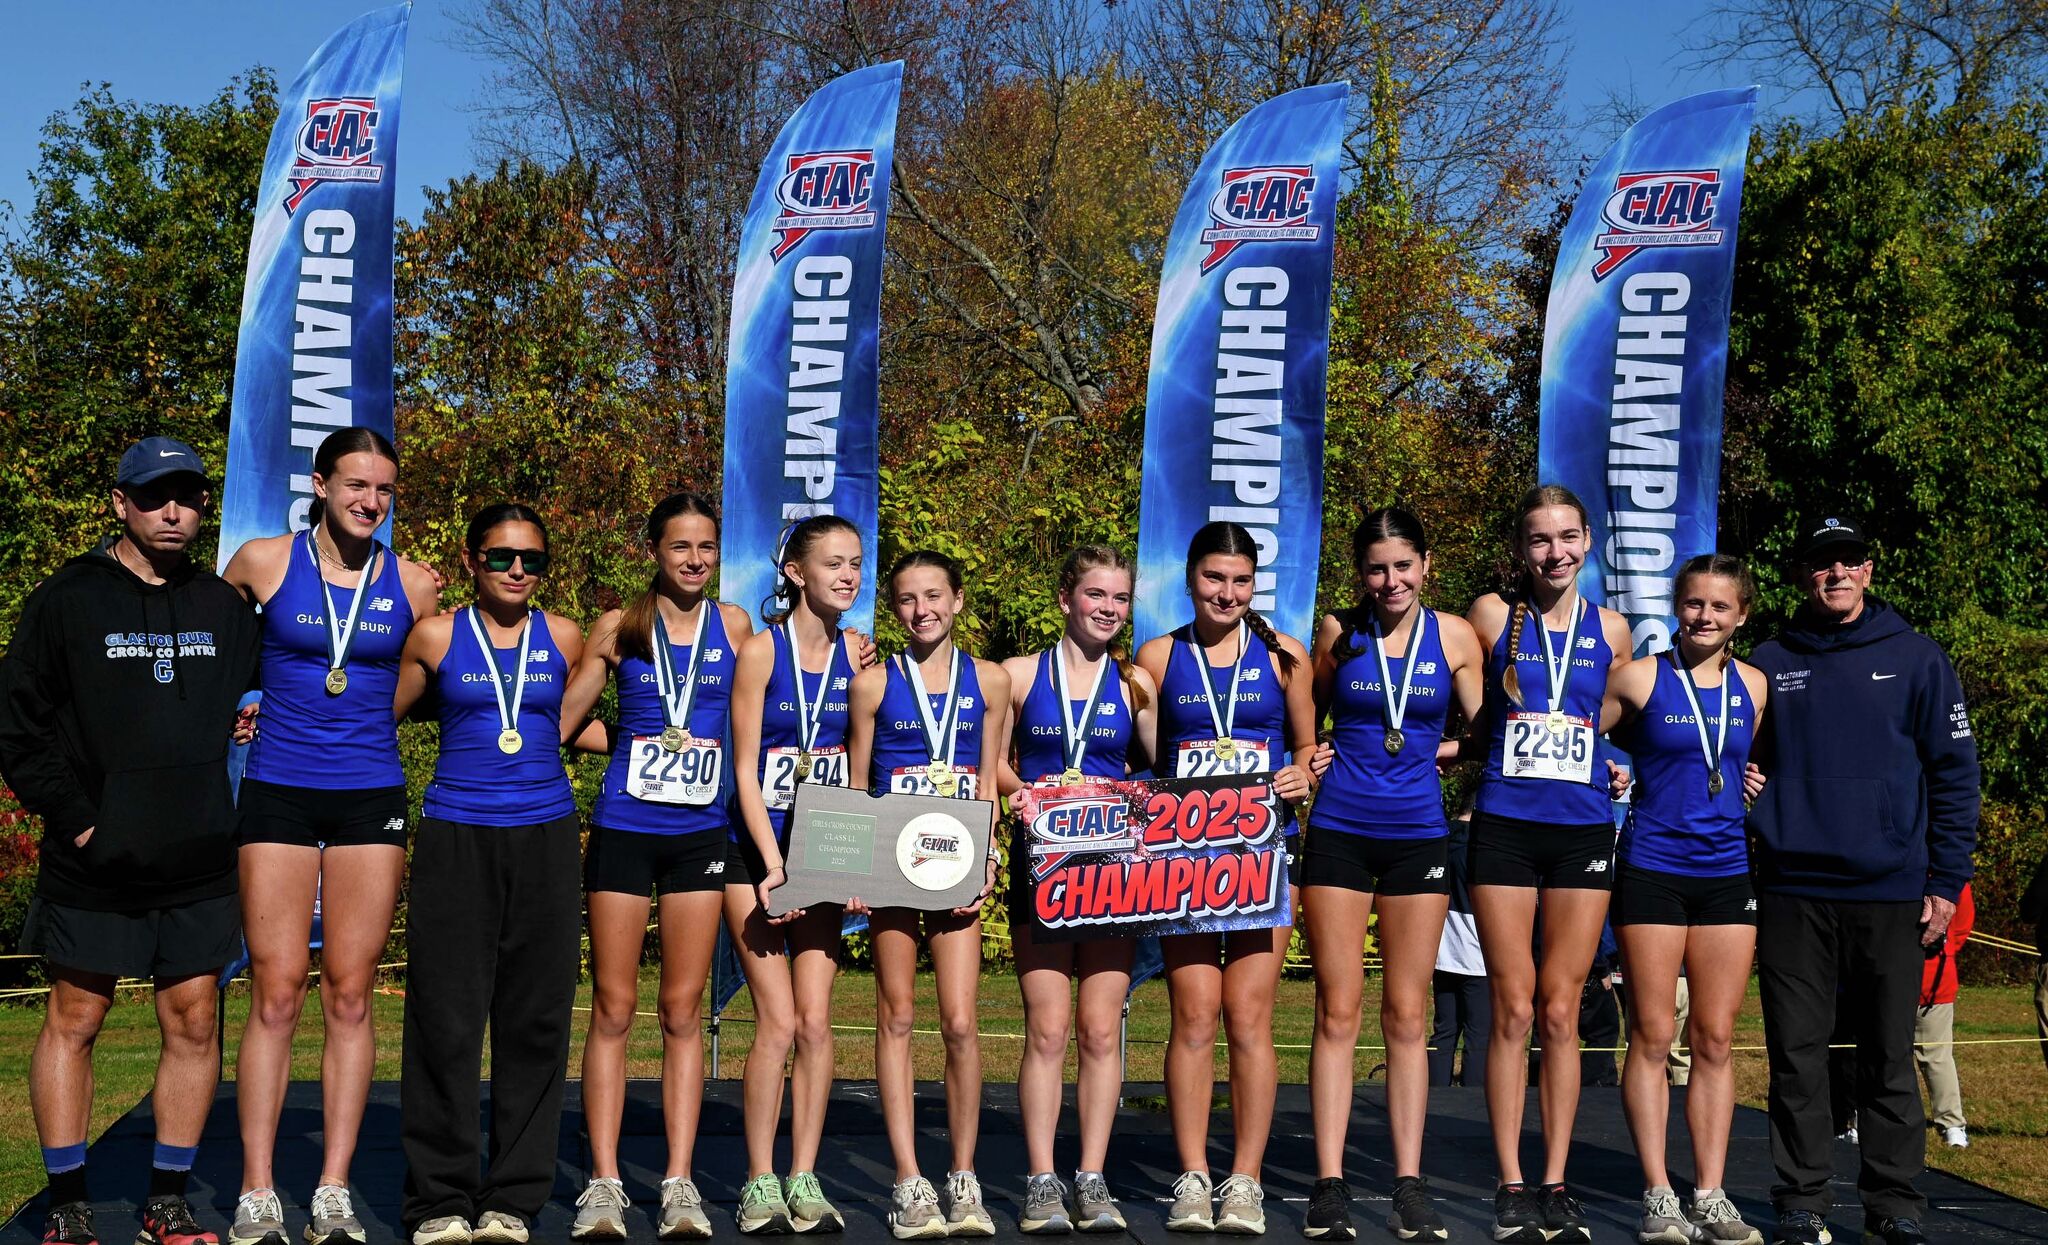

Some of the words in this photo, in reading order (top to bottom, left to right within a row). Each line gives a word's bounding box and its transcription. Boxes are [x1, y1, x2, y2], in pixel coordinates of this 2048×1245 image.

[791, 163, 875, 207] CIAC
[1226, 178, 1315, 220] CIAC
[1620, 183, 1720, 225] CIAC
[296, 613, 392, 634] GLAOBURY
[153, 659, 175, 683] G
[1513, 721, 1586, 762] 2295
[639, 743, 717, 785] 2290
[773, 756, 843, 791] 294
[1048, 804, 1128, 837] CIAC
[1143, 785, 1273, 848] 2025
[921, 837, 959, 852] CIAC
[1035, 851, 1278, 926] CHAMPION
